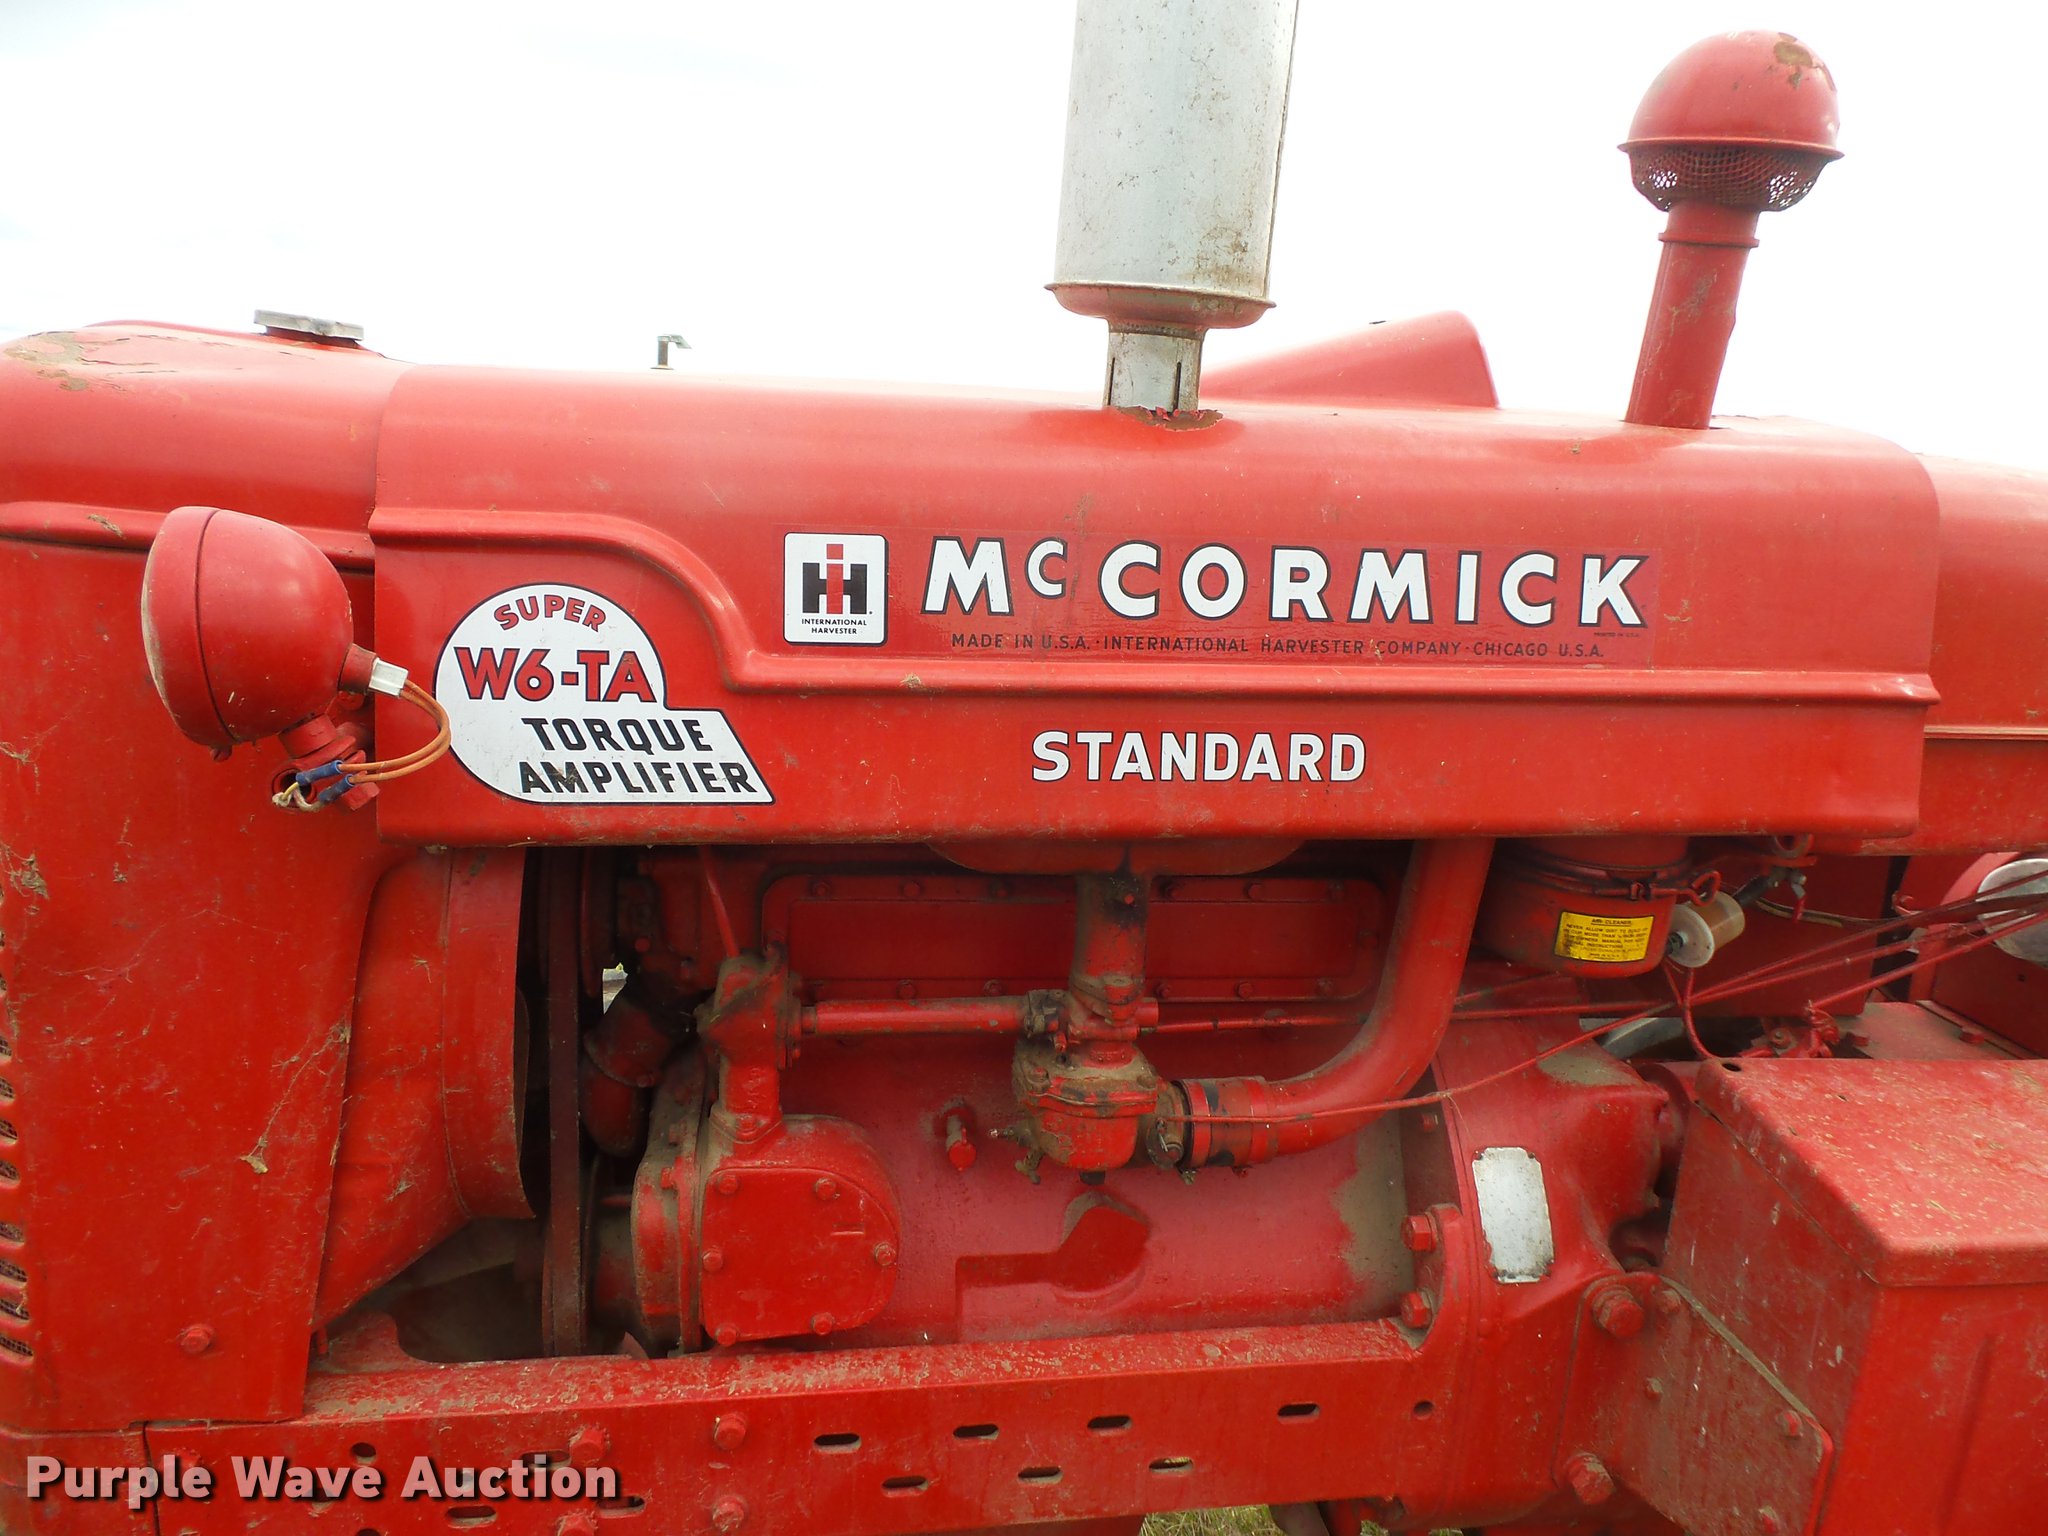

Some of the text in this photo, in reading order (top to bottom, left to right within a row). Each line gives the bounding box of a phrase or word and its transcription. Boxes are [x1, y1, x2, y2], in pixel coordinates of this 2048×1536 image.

[493, 594, 607, 633] SUPER
[801, 618, 867, 626] INTERNATIONAL
[811, 627, 857, 635] HARVESTER
[952, 633, 1604, 658] MADE IN U.S.A. INTERNATIONAL HARVESTER COMPANY CHICAGO U.S.A.
[453, 646, 658, 703] W6-TA
[520, 717, 713, 756] TORQUE
[1031, 730, 1367, 783] STANDARD
[518, 761, 758, 794] AMPLIFIER
